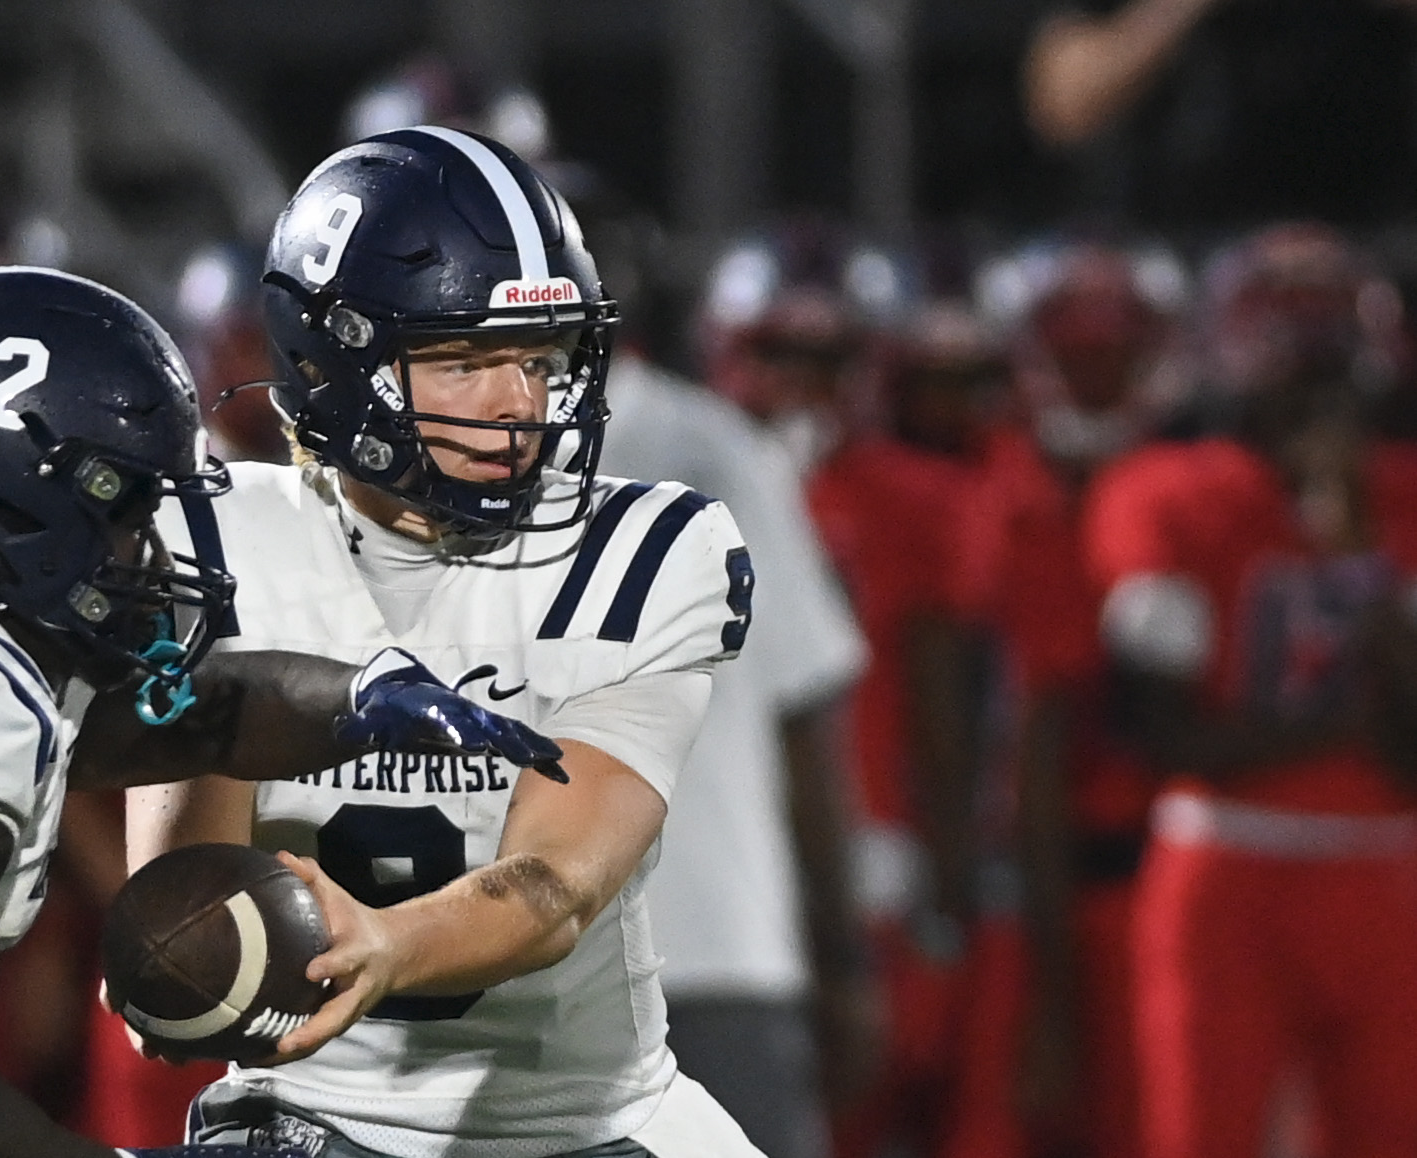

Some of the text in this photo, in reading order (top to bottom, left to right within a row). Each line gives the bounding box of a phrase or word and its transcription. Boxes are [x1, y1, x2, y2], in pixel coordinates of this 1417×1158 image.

[302, 192, 363, 286] 9
[505, 282, 573, 303] Riddell
[721, 546, 755, 654] 9
[290, 744, 510, 793] ERPRISE
